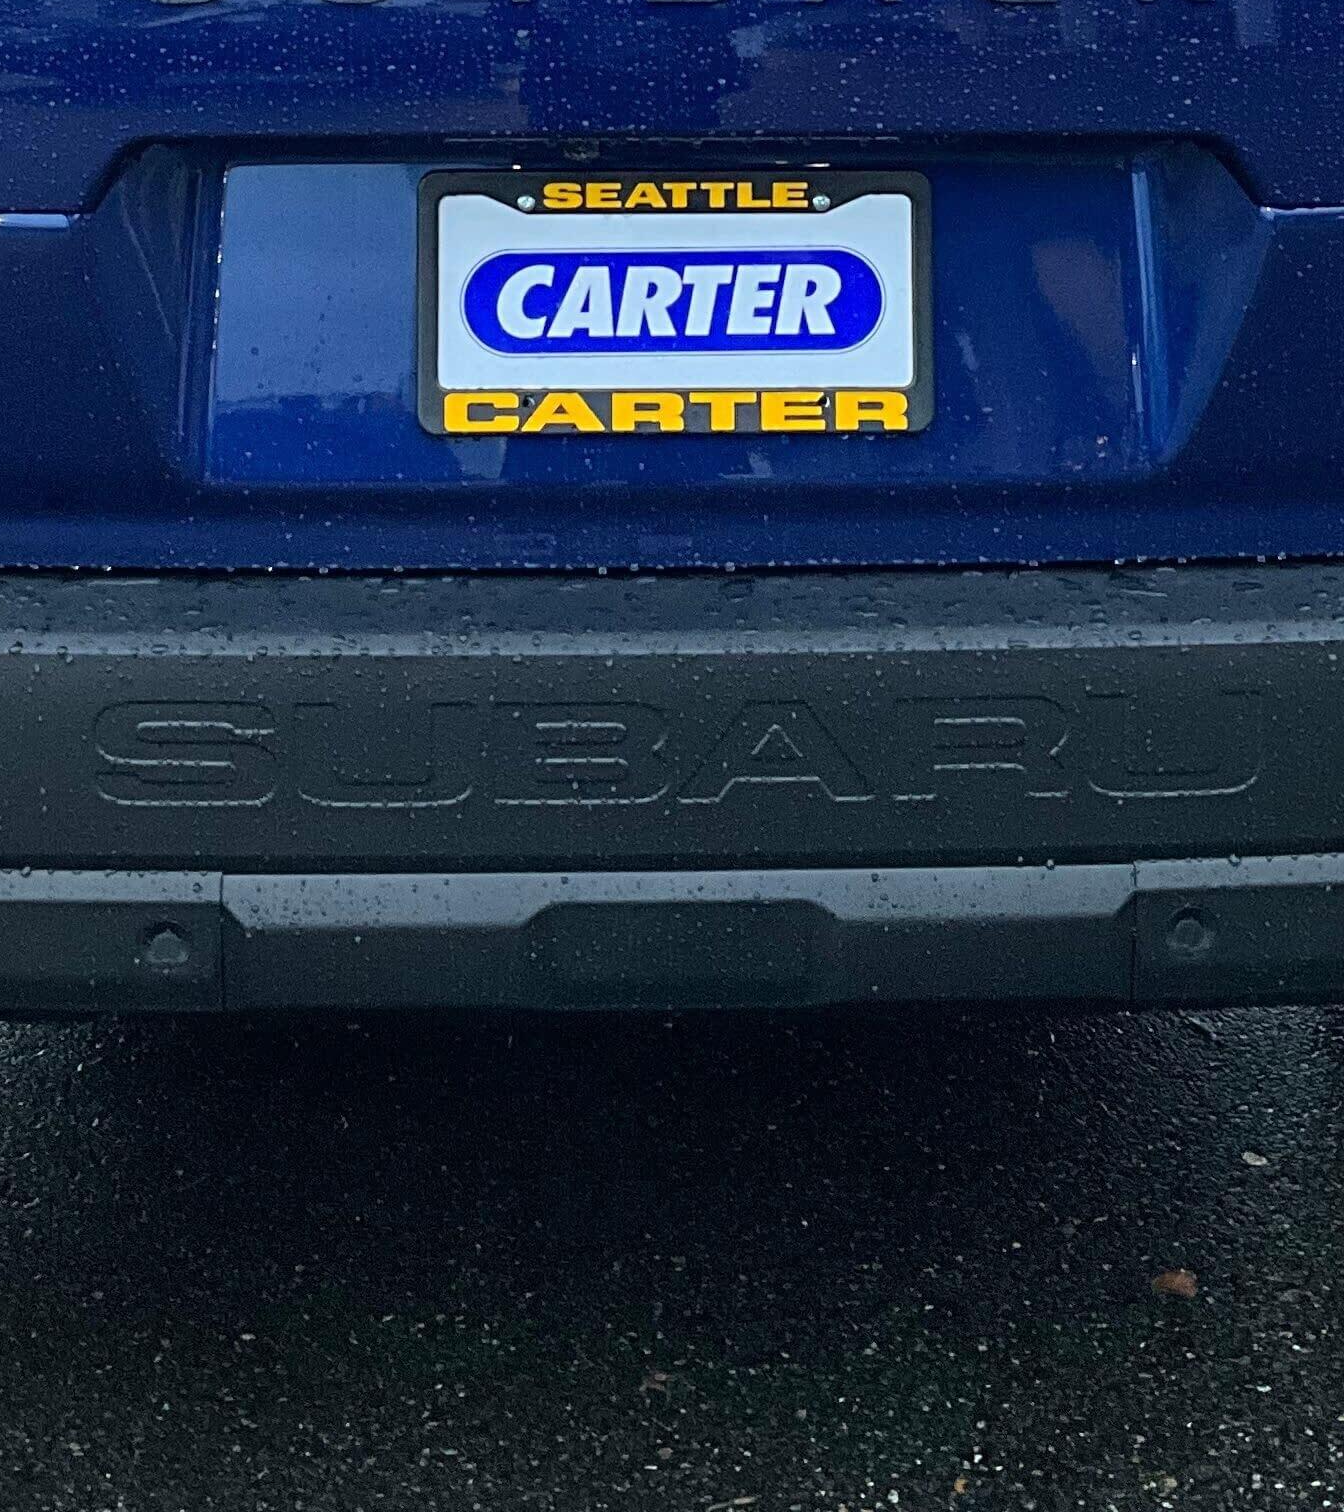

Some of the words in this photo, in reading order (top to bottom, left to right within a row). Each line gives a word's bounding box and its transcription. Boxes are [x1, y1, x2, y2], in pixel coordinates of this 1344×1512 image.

[542, 181, 809, 209] SEATTLE
[495, 263, 843, 339] CARTER
[442, 390, 910, 434] CARTER
[92, 687, 1264, 807] SUBARU
